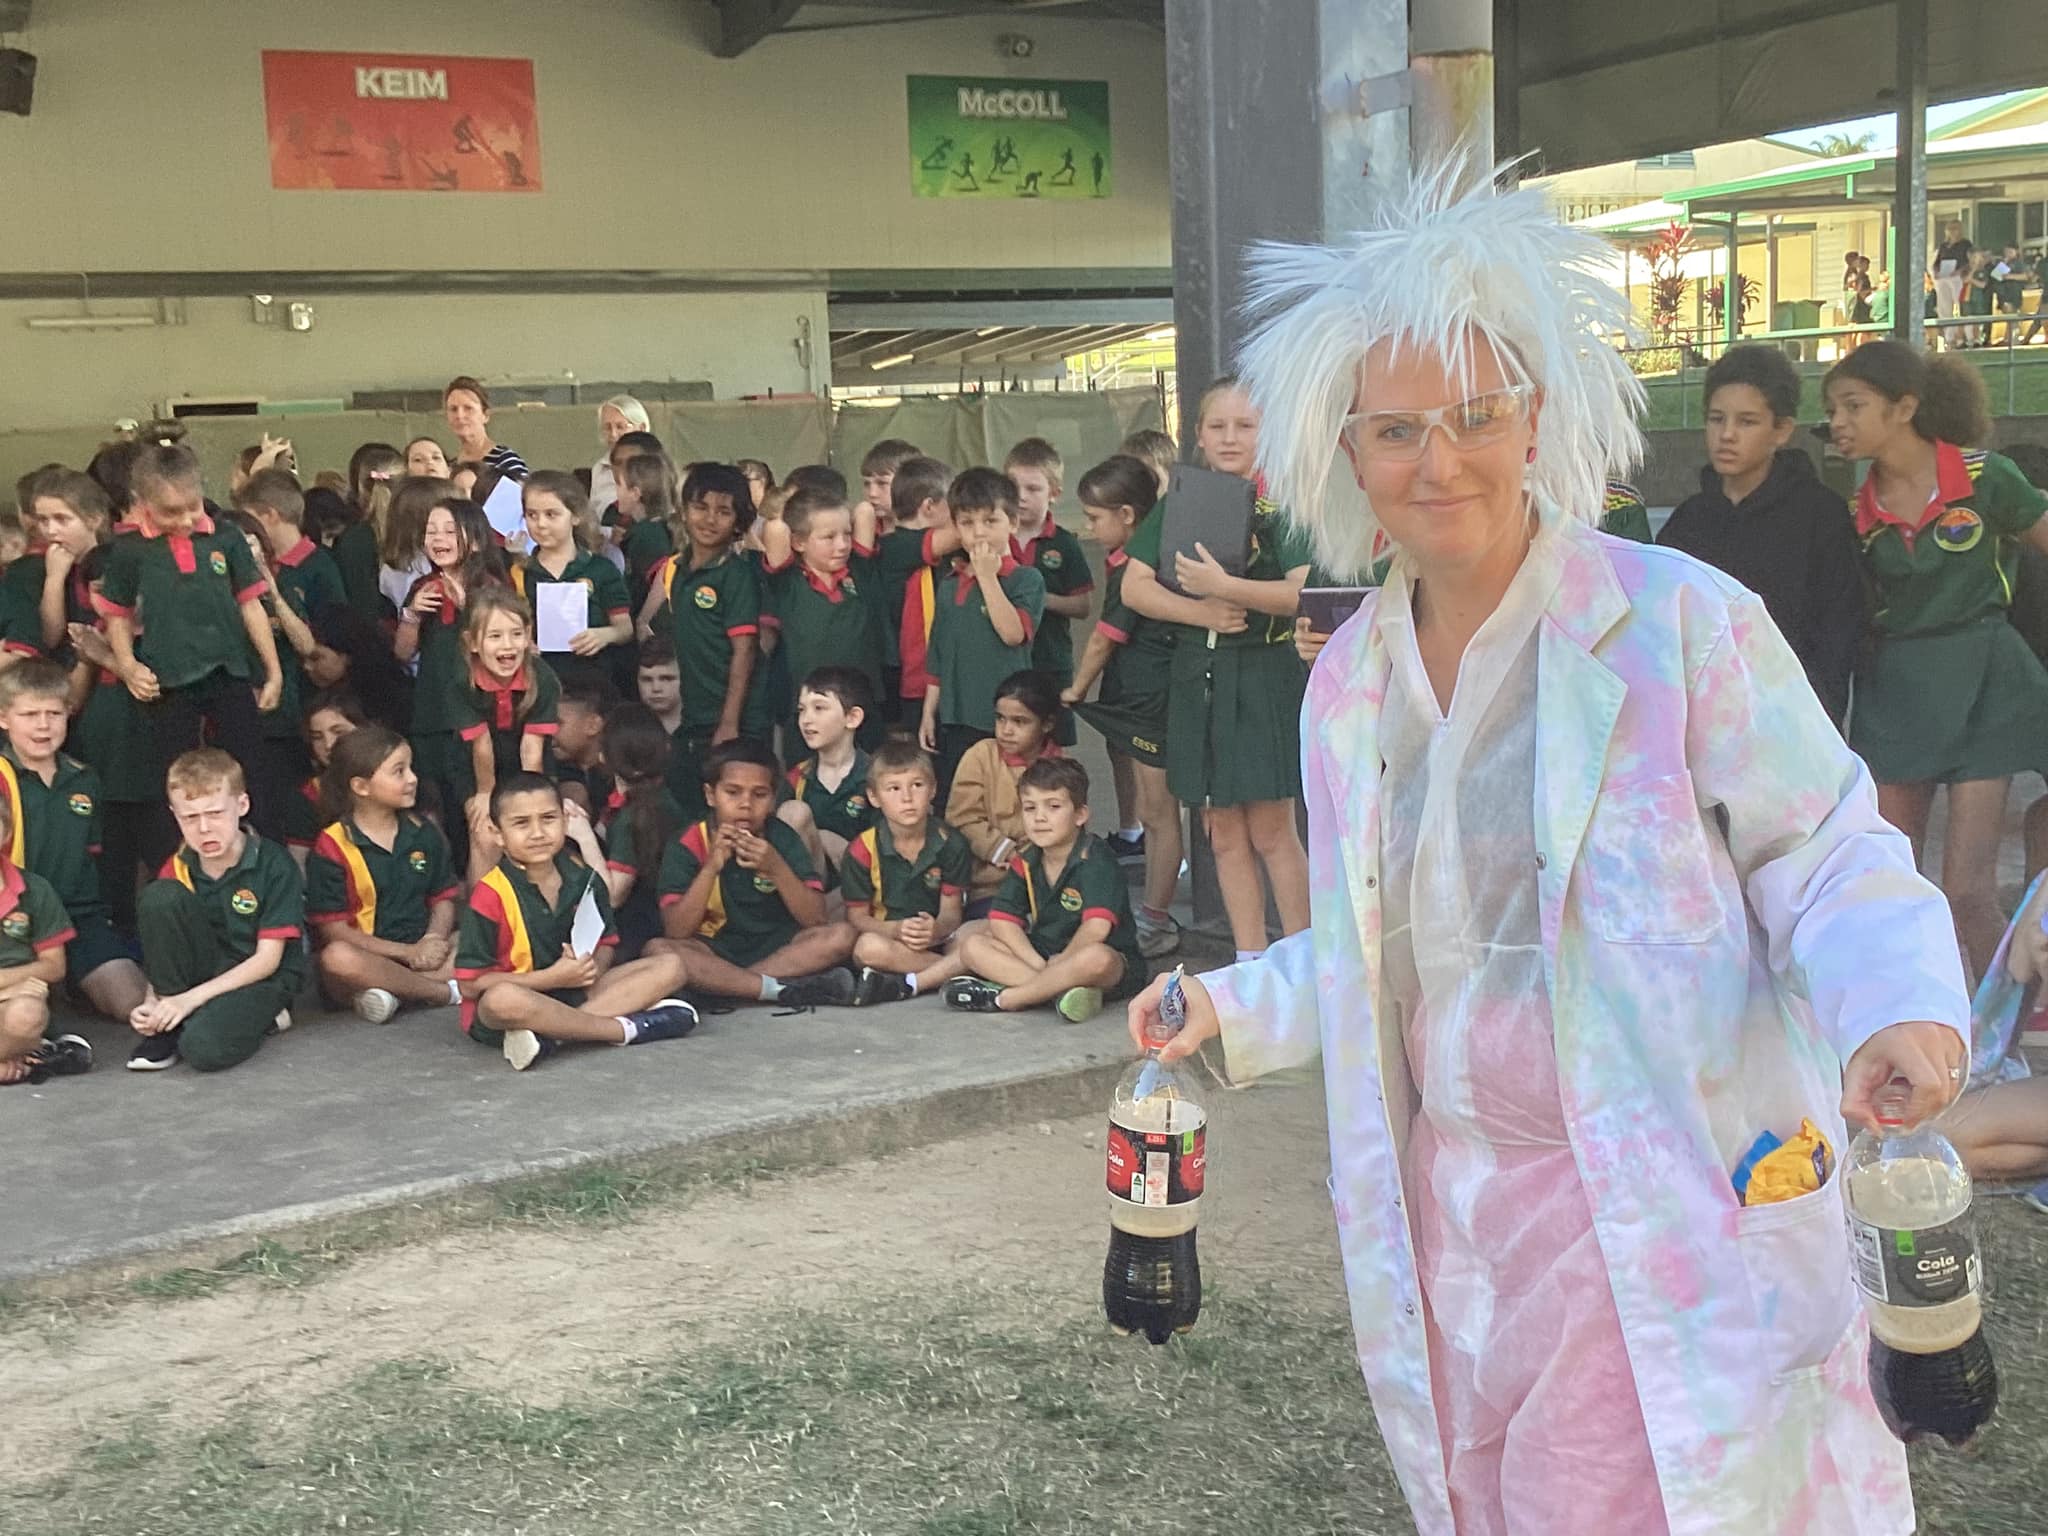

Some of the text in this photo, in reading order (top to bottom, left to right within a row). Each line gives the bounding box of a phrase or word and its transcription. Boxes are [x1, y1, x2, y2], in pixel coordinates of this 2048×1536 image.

[355, 67, 447, 99] KEIM
[958, 87, 1066, 119] McCOLL
[1108, 1149, 1124, 1167] Cola
[1917, 1255, 1955, 1272] Cola
